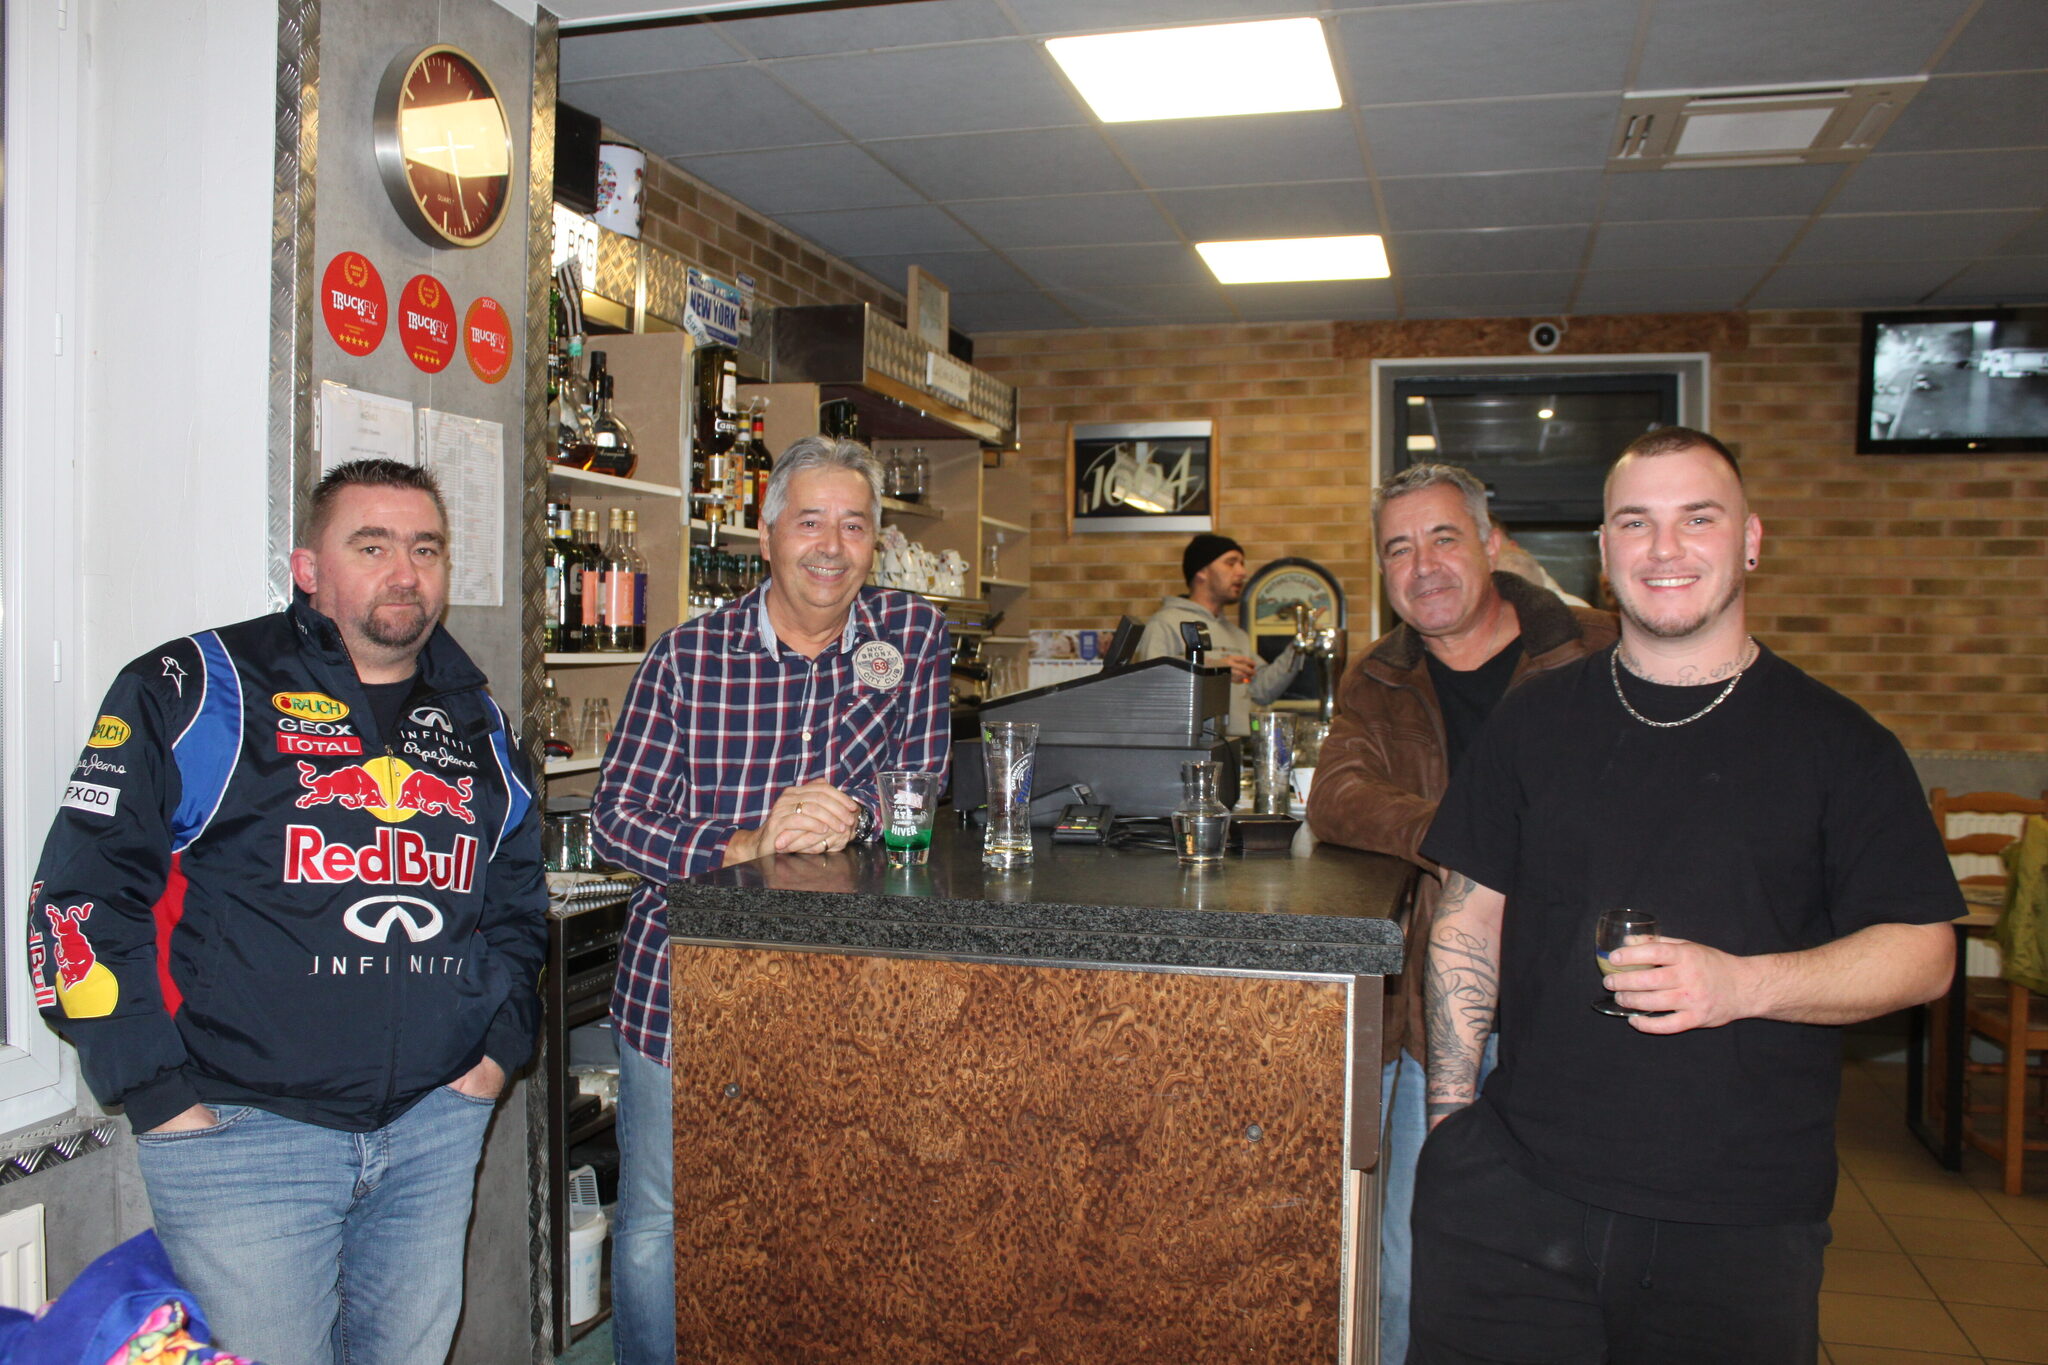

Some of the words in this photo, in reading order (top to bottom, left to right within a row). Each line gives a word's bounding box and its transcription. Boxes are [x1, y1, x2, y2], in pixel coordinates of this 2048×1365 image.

[331, 290, 378, 319] TRUCKFLY
[482, 299, 497, 310] 2023
[690, 289, 712, 320] NEW
[713, 300, 737, 331] YORK
[407, 311, 449, 338] TRUCKFLY
[471, 327, 506, 349] TRUCKFLY
[862, 651, 892, 659] BRONX
[864, 672, 881, 684] CITY
[885, 669, 900, 684] CLUB
[291, 697, 341, 714] RAUCH
[278, 718, 354, 735] GEOX
[281, 735, 359, 752] TOTAL
[400, 730, 472, 754] INFINITI
[891, 824, 918, 837] HIVER
[312, 955, 463, 976] INFINITI
